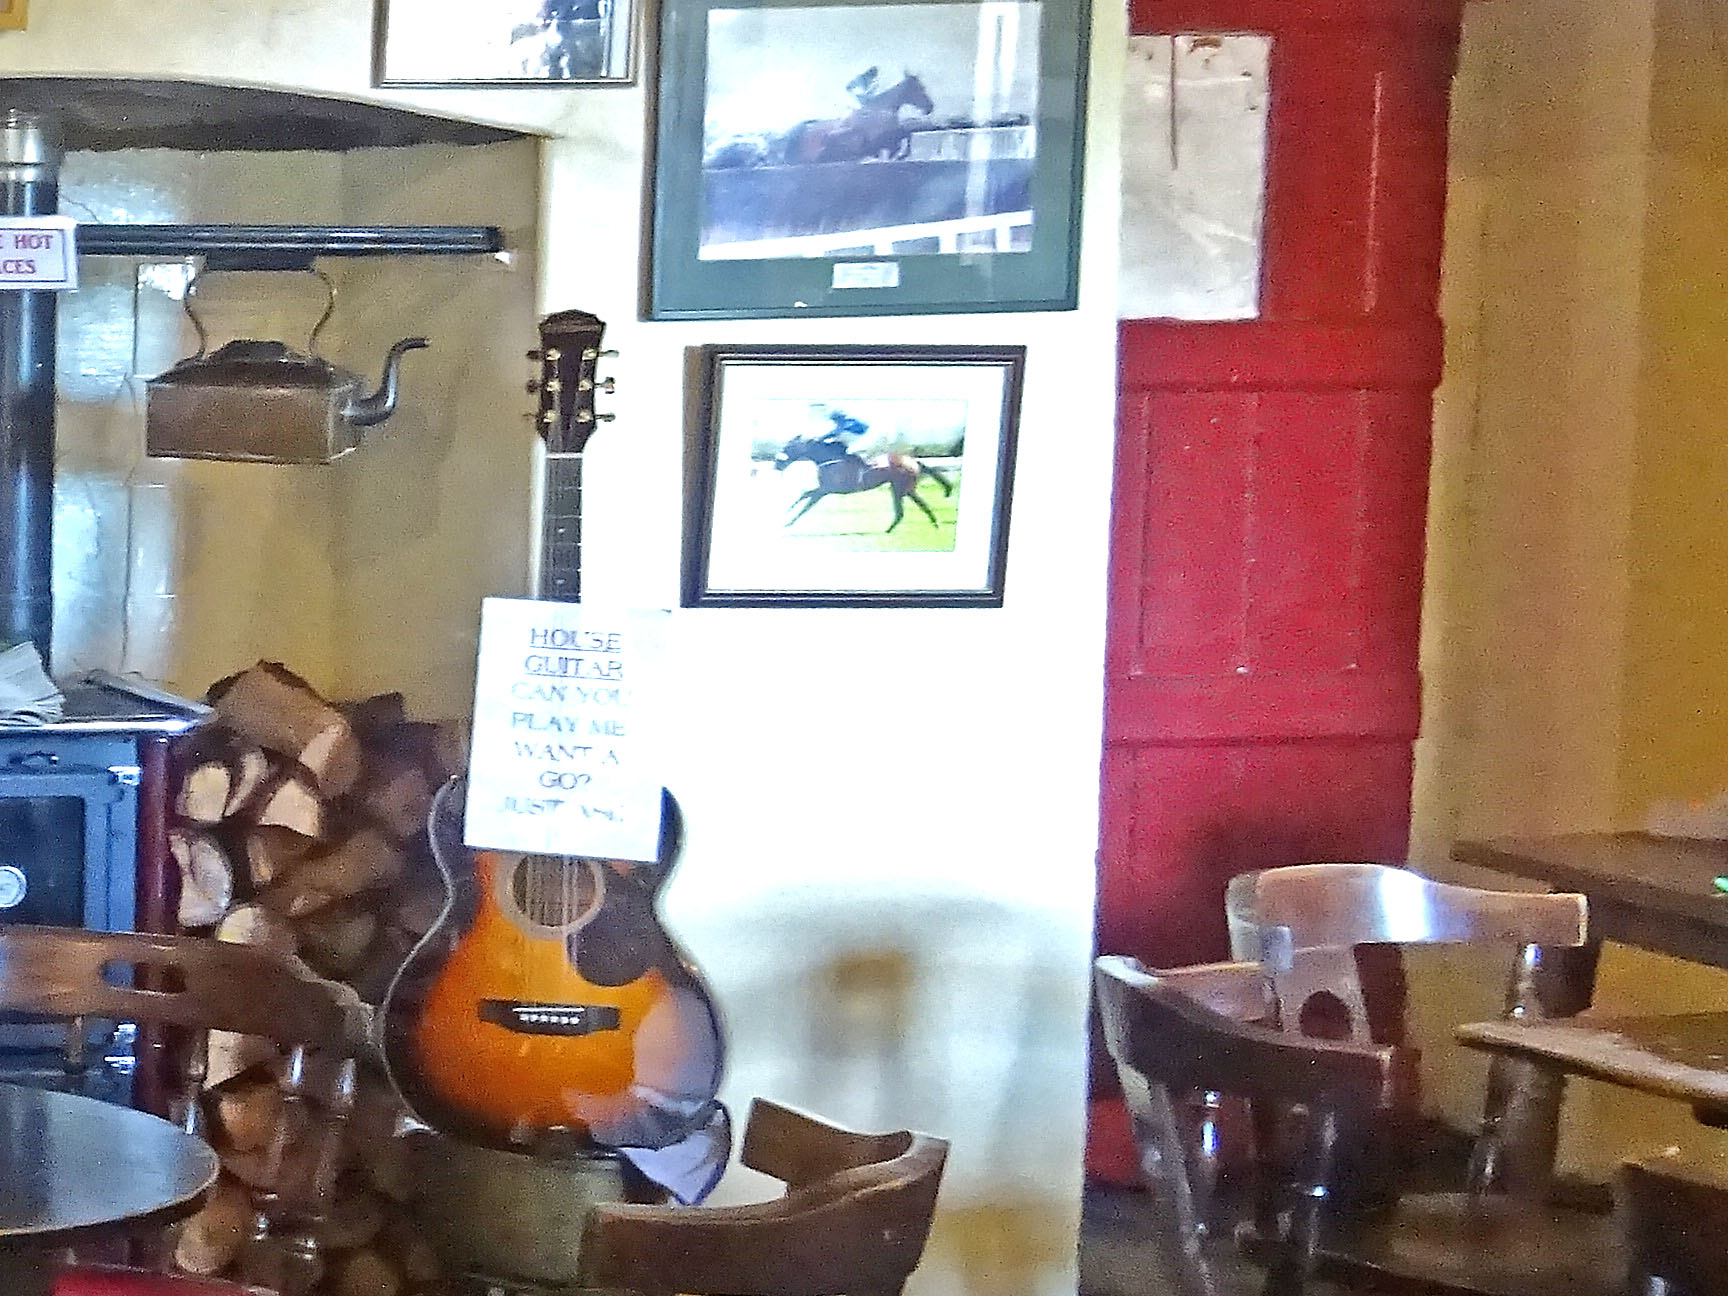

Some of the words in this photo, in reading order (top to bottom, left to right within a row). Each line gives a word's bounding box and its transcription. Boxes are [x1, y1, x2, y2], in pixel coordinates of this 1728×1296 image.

[15, 234, 54, 250] HOT
[529, 627, 623, 651] HOUSE
[524, 654, 623, 679] GUITAR
[538, 769, 593, 791] GO?
